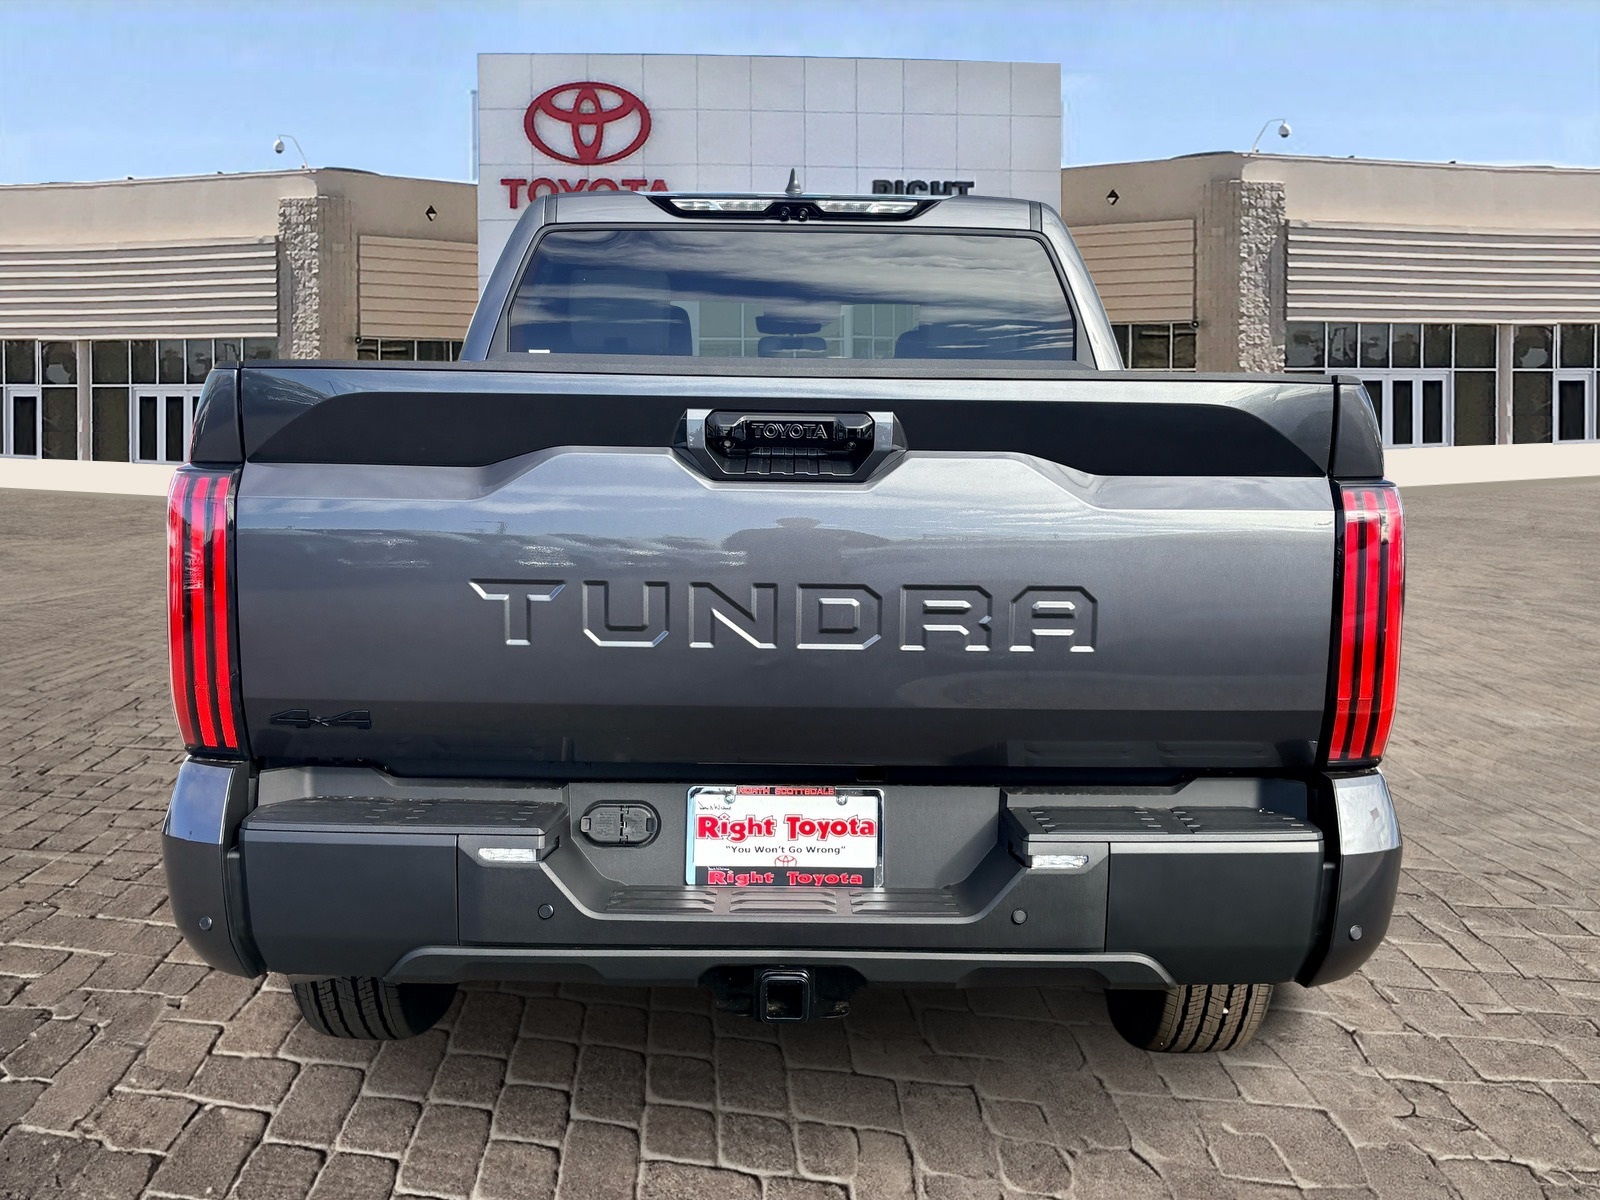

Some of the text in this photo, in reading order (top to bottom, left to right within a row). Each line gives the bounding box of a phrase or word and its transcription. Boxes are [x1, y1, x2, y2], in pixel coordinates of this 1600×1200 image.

[751, 423, 828, 439] TOYOTA
[468, 579, 1099, 654] TUNDRA
[696, 813, 876, 843] Right Toyota
[788, 846, 803, 854] Go
[707, 870, 863, 887] Right Toyota
